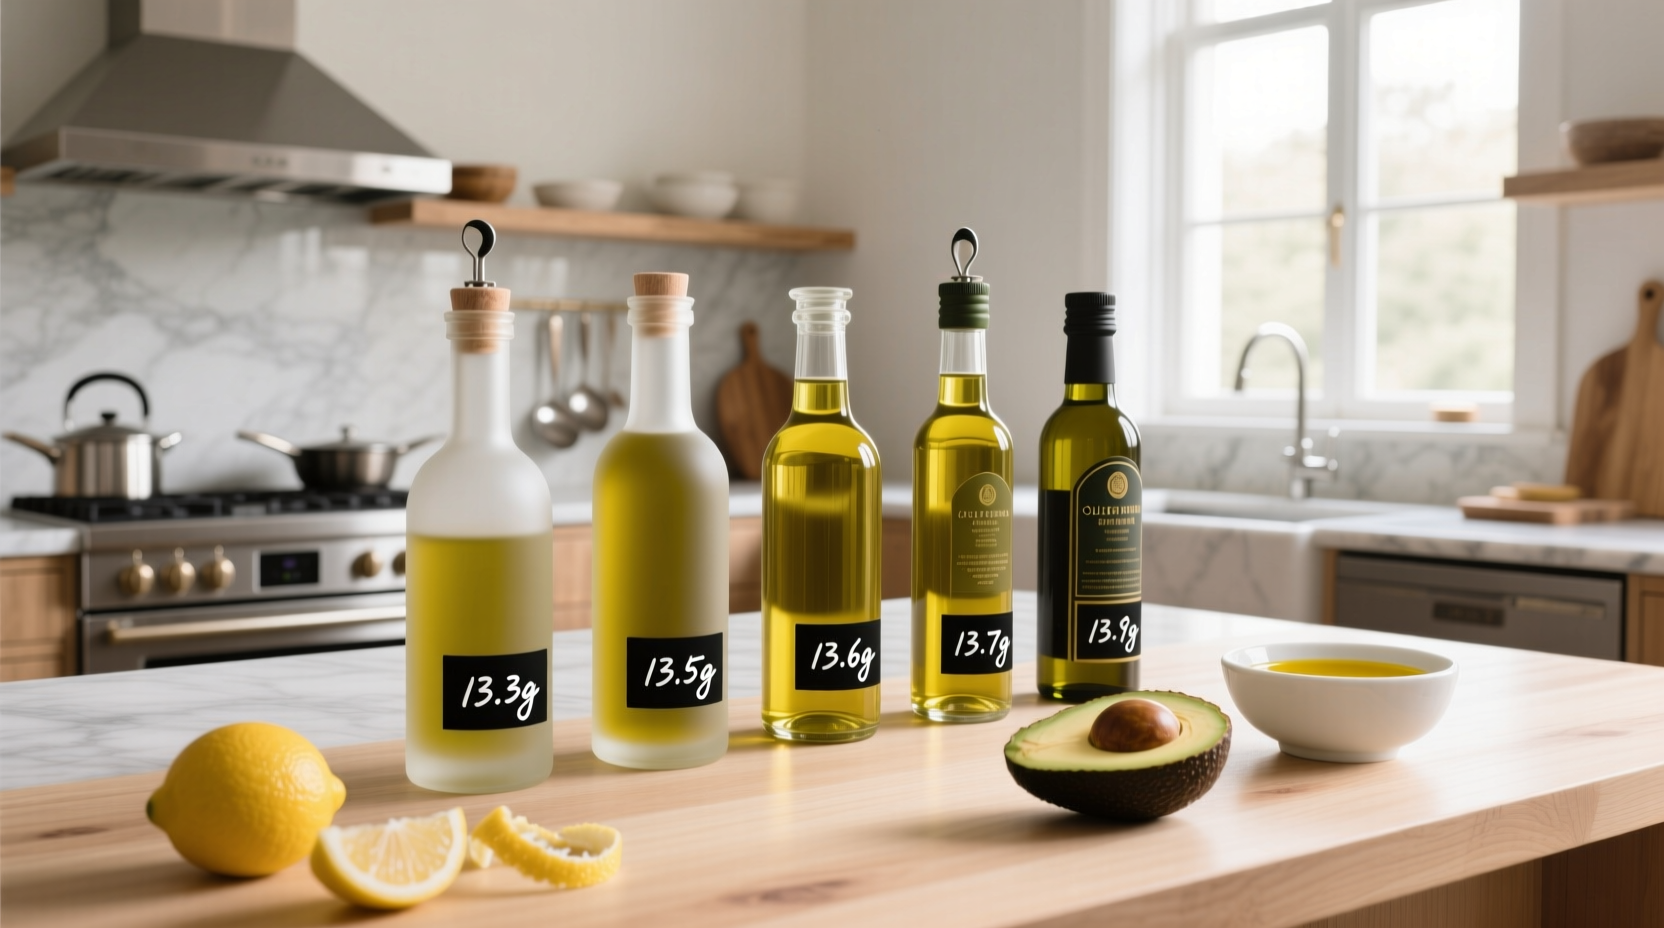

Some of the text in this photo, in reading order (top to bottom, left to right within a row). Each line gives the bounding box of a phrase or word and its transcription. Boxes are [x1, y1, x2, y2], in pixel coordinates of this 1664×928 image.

[954, 629, 1011, 669] 13.7g
[1088, 615, 1140, 654] 13.9g
[644, 654, 717, 700] 13.5g
[811, 637, 876, 683] 13.6g
[461, 674, 540, 722] 13.3g
